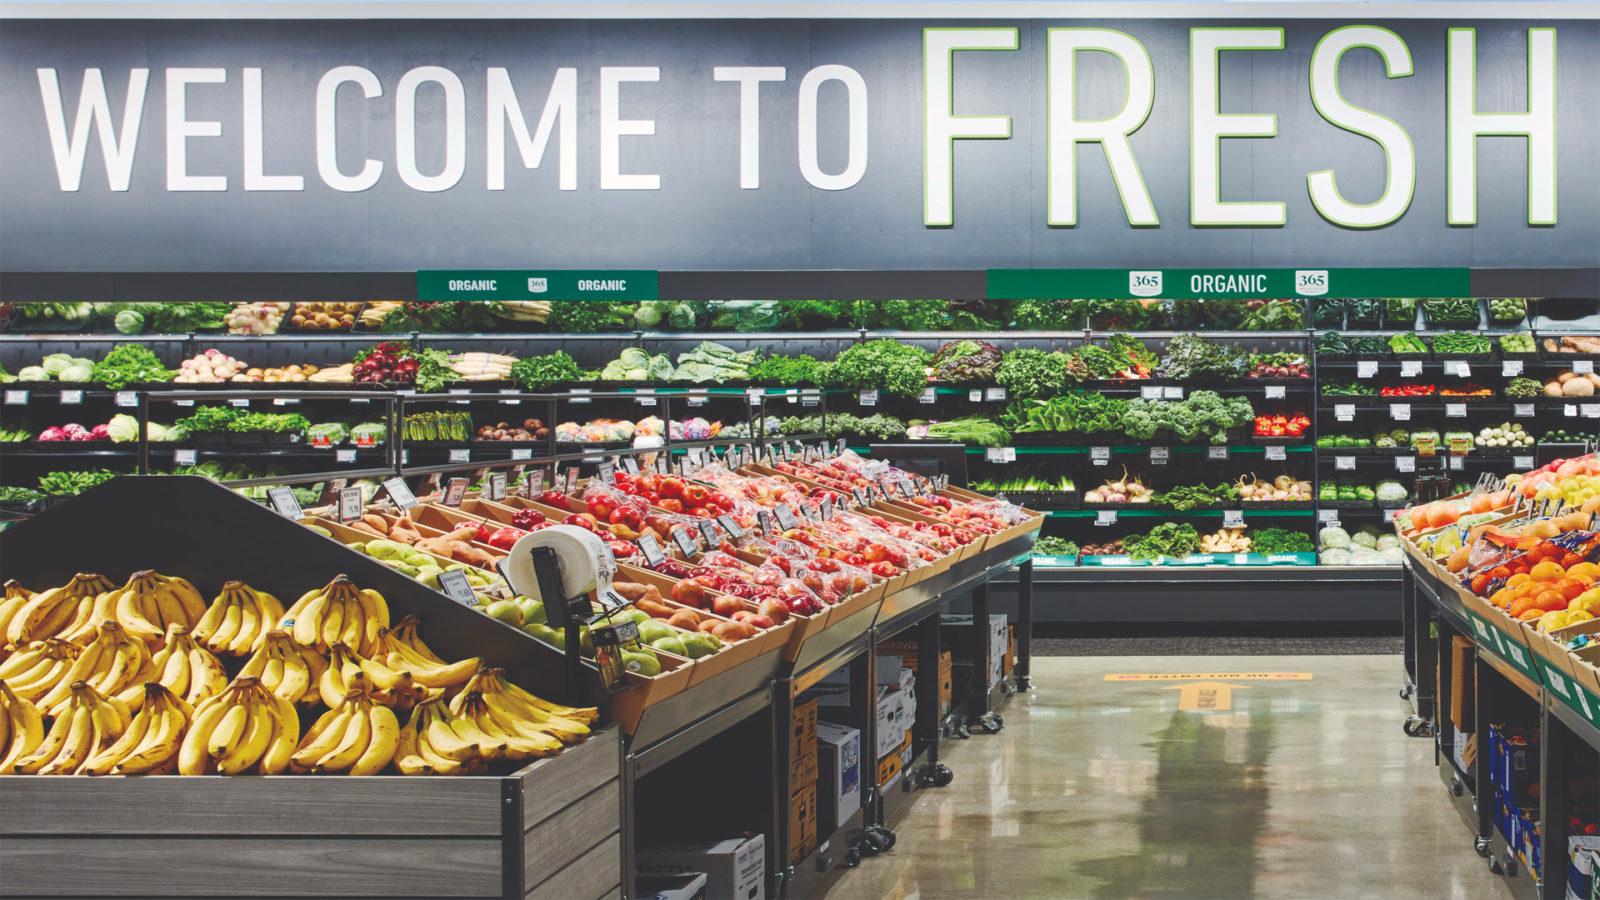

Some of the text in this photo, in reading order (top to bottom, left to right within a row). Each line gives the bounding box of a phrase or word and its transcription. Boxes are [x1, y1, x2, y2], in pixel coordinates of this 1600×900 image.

[37, 25, 1558, 229] WELCOME TO FRESH
[449, 279, 497, 291] ORGANIC
[578, 279, 626, 291] ORGANIC
[1132, 274, 1325, 293] 365 ORGANIC 365
[1267, 555, 1298, 563] ORGANIC
